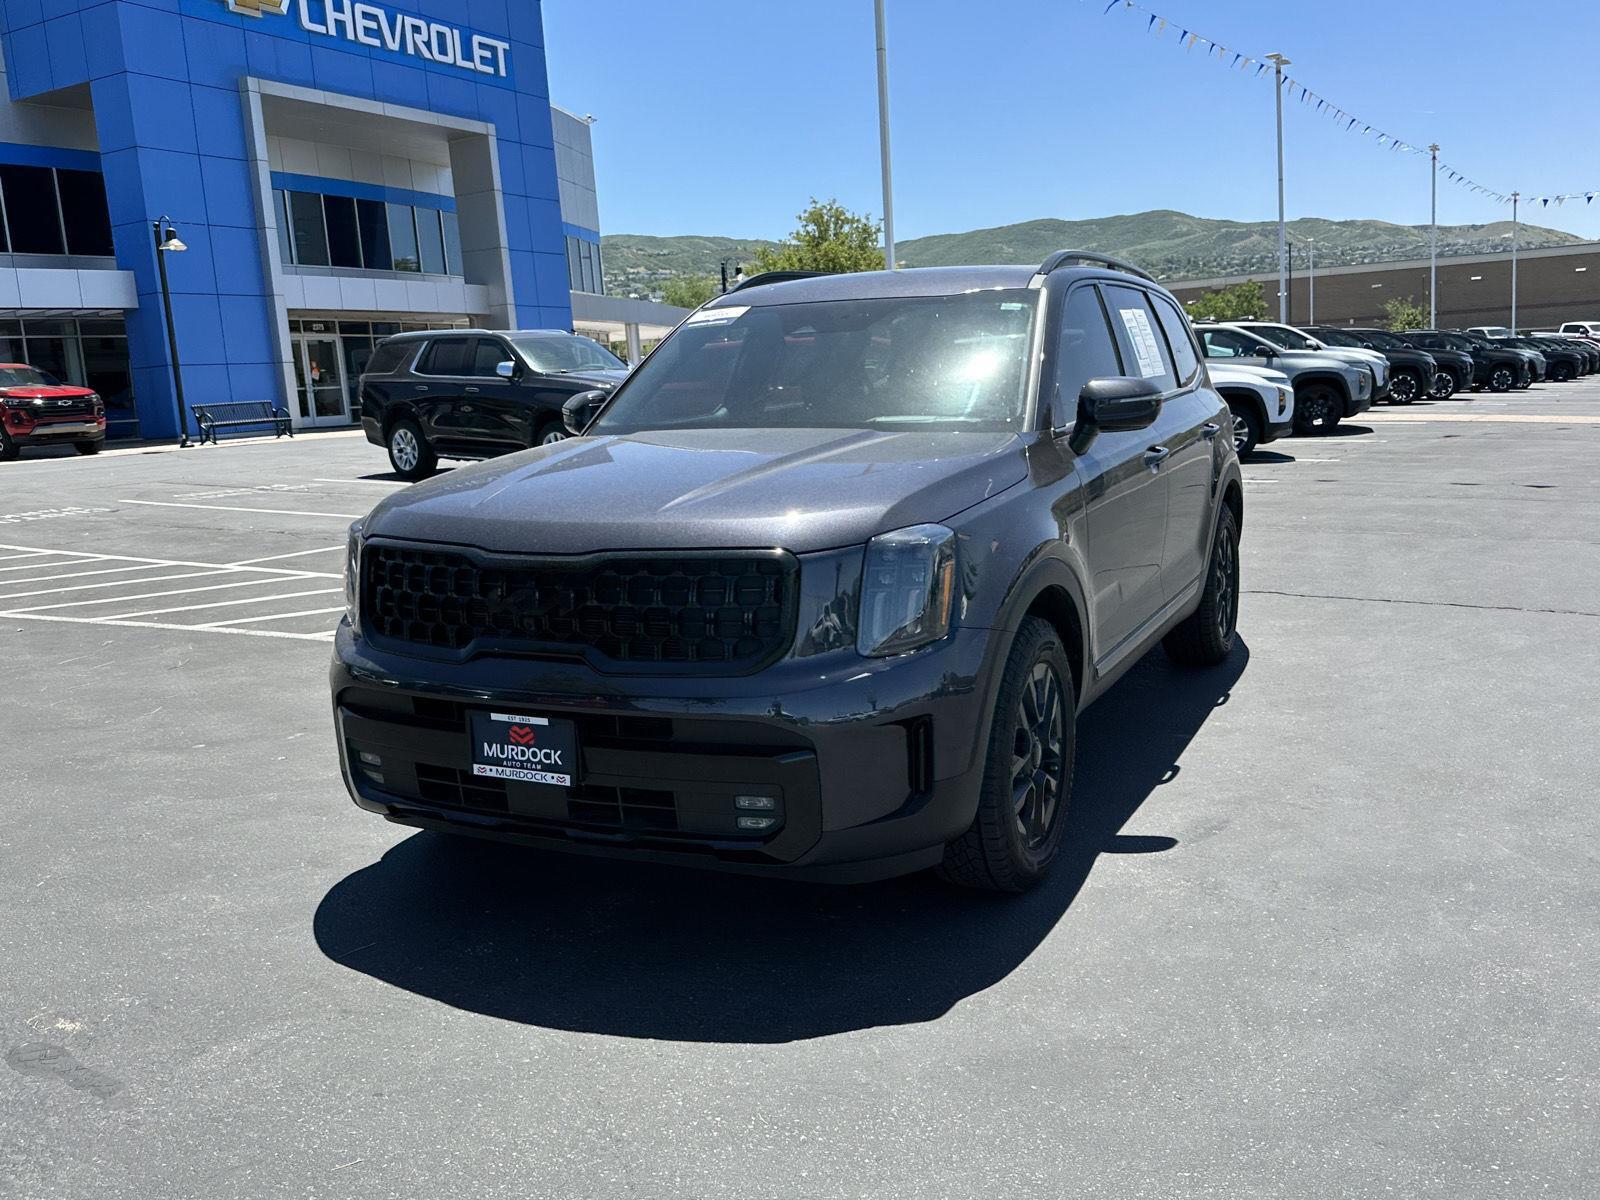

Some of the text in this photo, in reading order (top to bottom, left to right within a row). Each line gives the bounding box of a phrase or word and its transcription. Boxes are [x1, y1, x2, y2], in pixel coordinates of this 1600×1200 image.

[299, 0, 509, 77] CHEVROLET
[483, 742, 562, 765] MURDOCK
[495, 767, 548, 782] MURDOCK
[502, 760, 542, 770] AUTO TEAM
